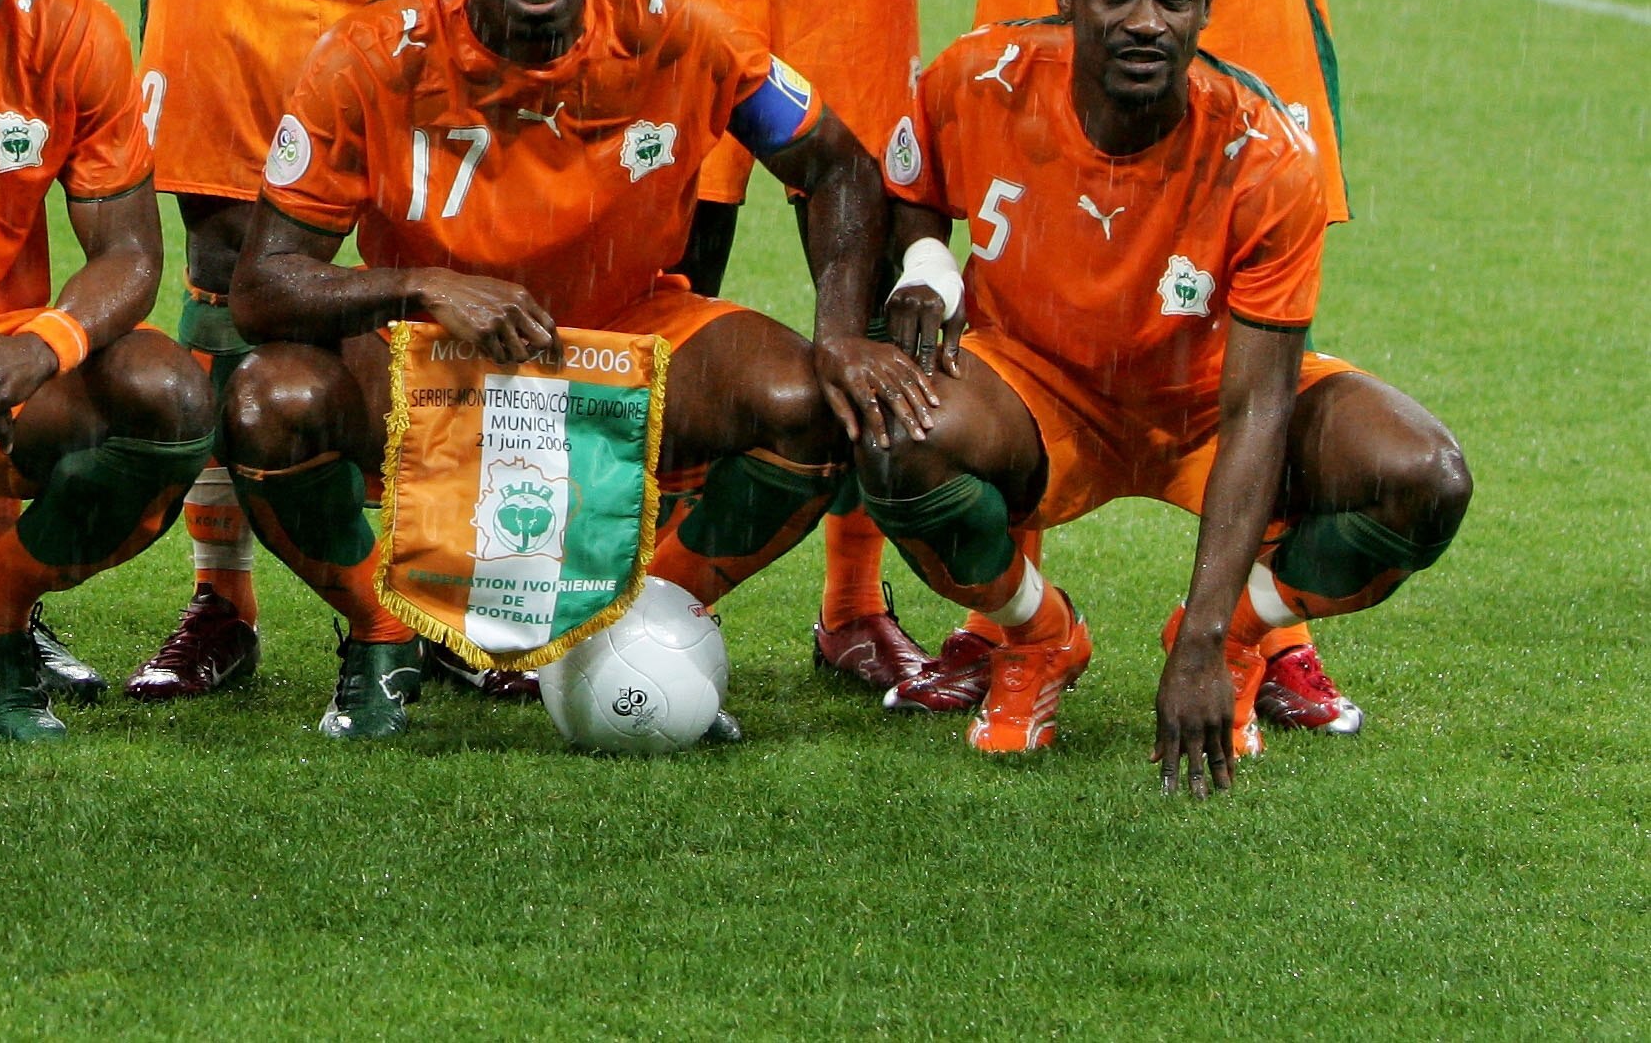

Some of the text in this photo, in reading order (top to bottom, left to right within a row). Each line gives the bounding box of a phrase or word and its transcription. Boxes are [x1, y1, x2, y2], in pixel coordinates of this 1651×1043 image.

[406, 125, 491, 221] 17
[971, 177, 1027, 262] 5
[565, 345, 633, 374] 2006
[491, 414, 556, 434] MUNICH
[476, 433, 573, 452] 21 juin 2006
[502, 483, 551, 498] FIF
[523, 579, 617, 593] IVOIRIENNE
[502, 595, 525, 607] DE
[467, 604, 554, 626] FOOTBALL
